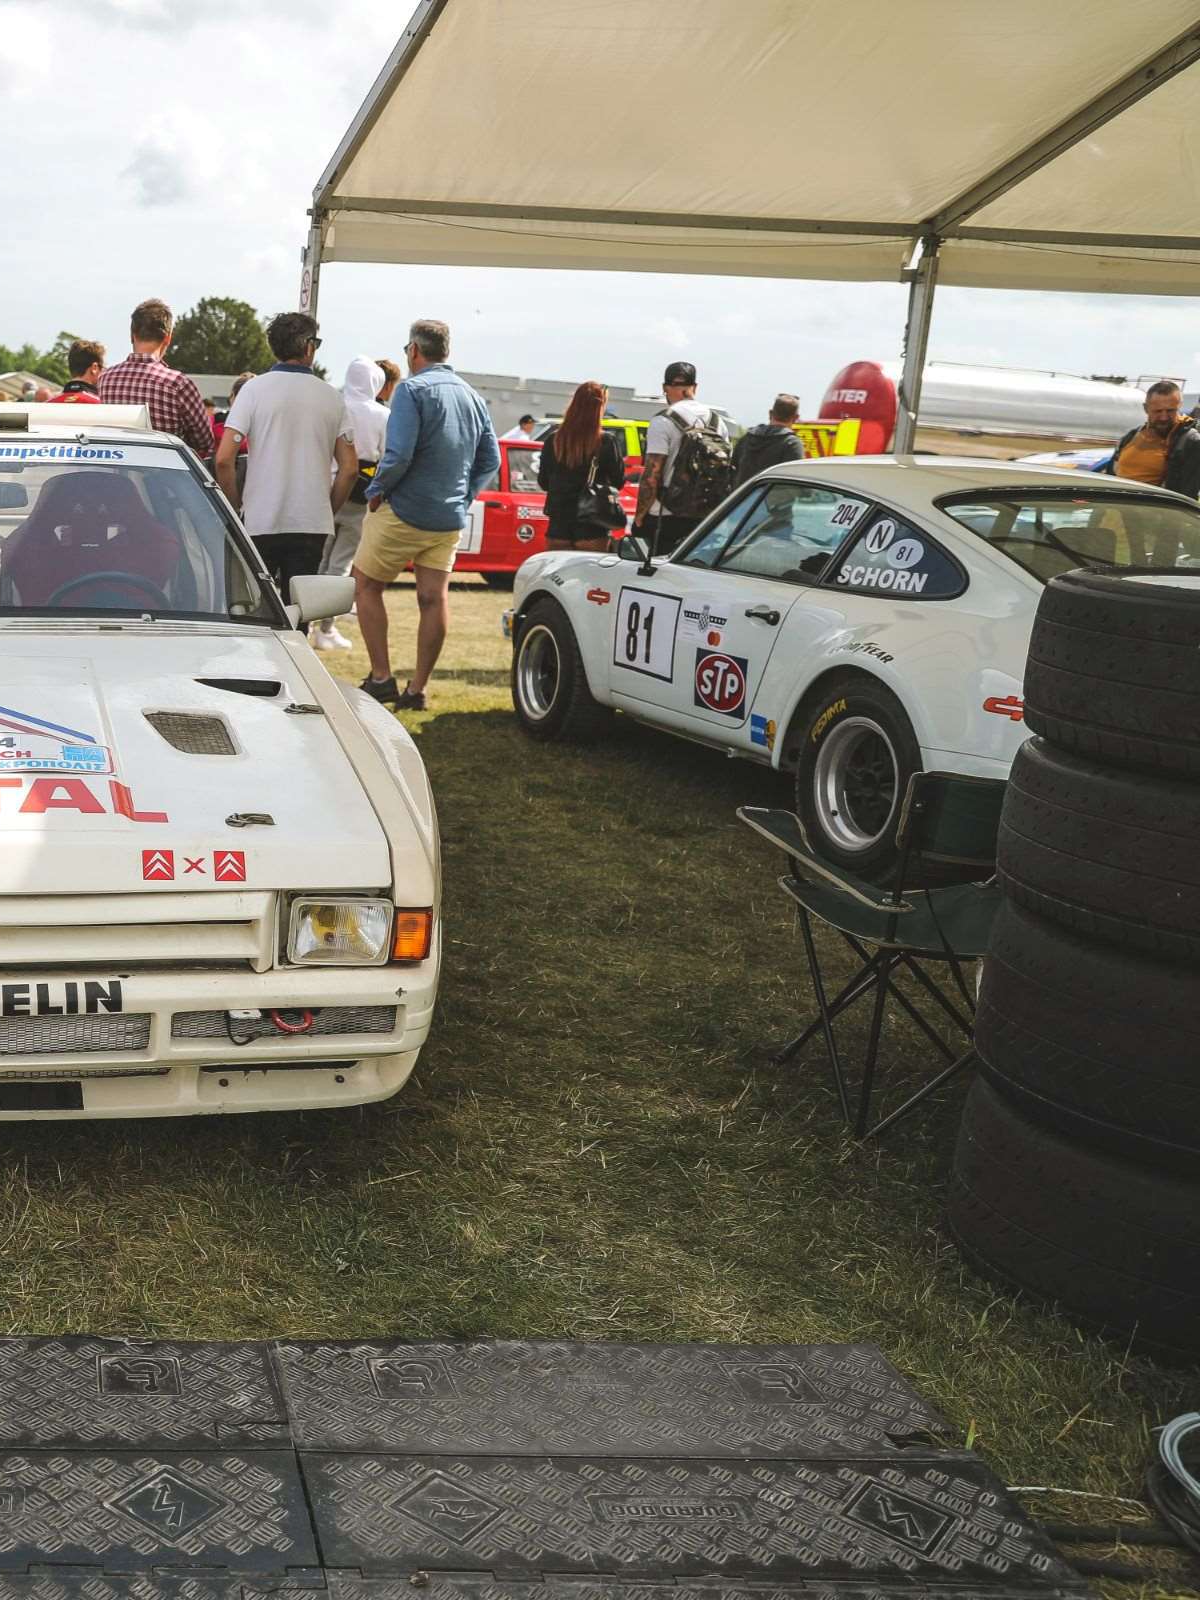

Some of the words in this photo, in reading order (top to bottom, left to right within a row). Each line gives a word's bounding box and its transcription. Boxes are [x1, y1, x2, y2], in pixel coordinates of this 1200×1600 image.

[831, 503, 860, 526] 204
[869, 524, 891, 549] N
[895, 546, 914, 562] 81
[837, 565, 928, 593] SCHORN
[625, 601, 655, 664] 81
[701, 660, 739, 702] STP
[610, 1505, 657, 1517] DOG
[660, 1505, 737, 1517] GUARD
